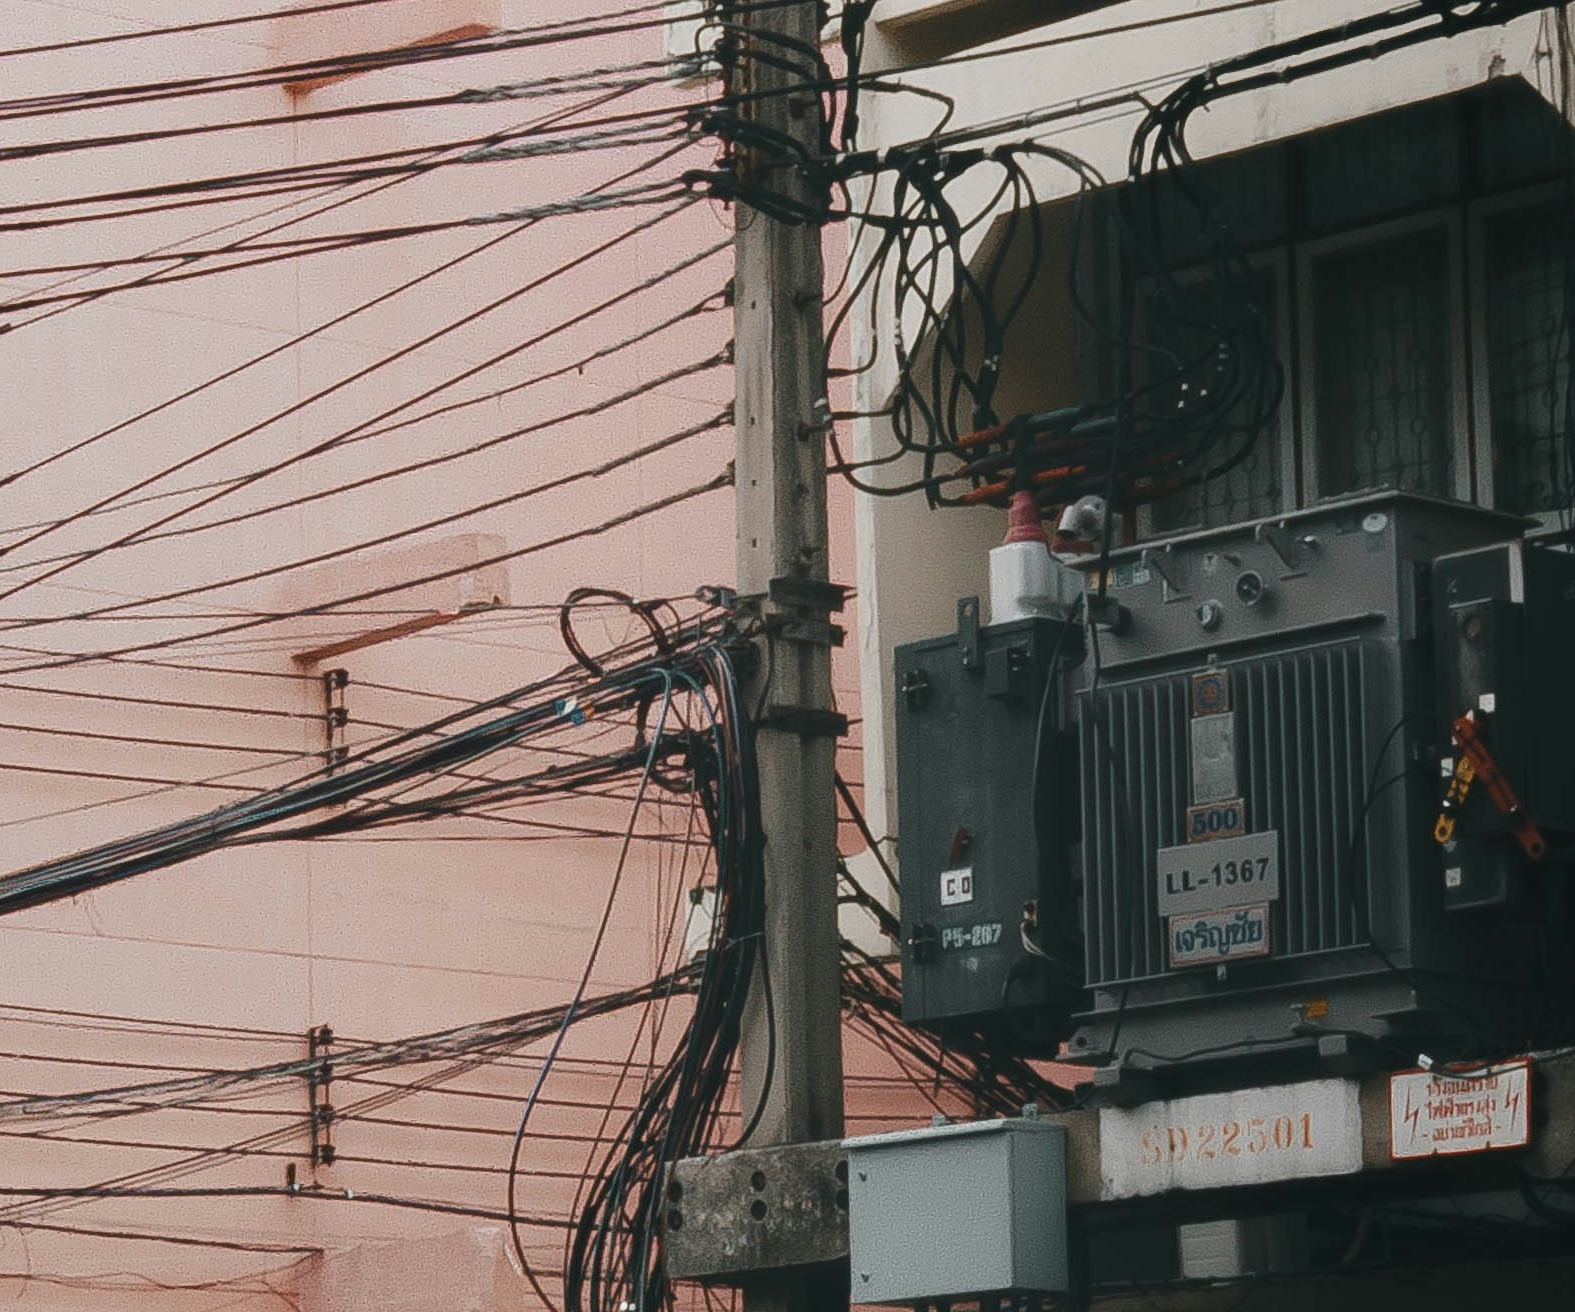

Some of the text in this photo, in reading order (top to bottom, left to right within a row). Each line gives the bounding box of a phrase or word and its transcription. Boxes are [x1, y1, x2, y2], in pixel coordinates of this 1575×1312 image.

[1192, 807, 1238, 835] 500
[1166, 857, 1270, 895] LL-1367
[1175, 910, 1263, 956] เจริญชัย
